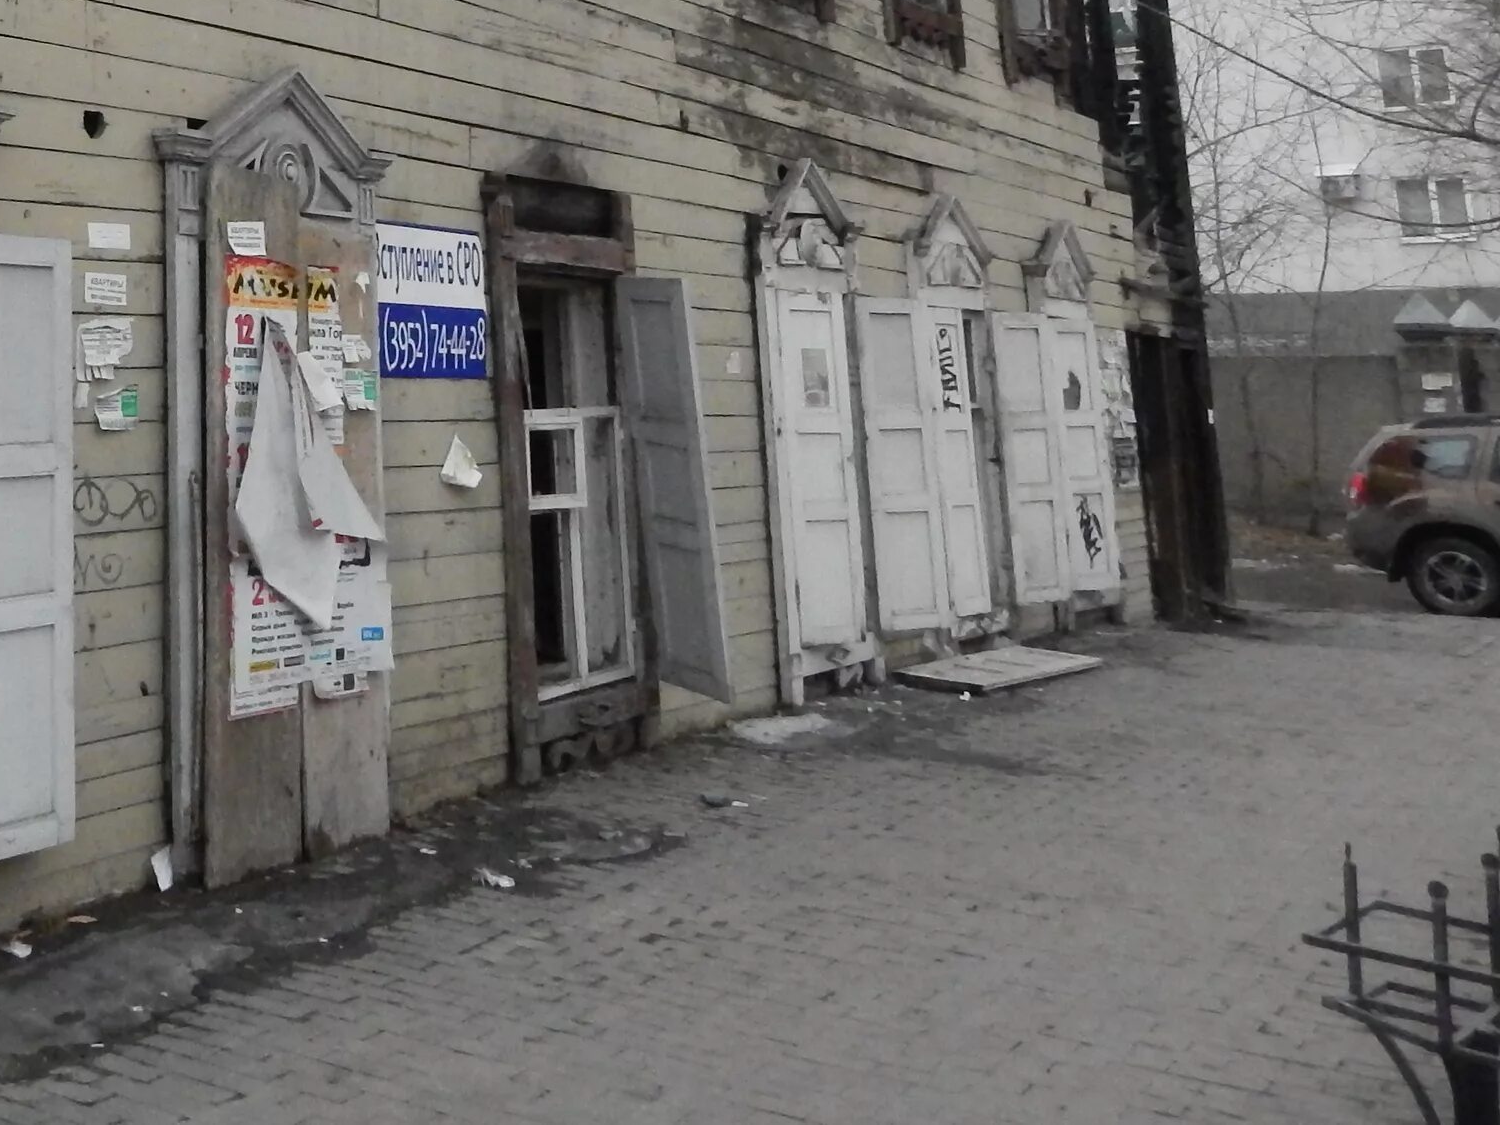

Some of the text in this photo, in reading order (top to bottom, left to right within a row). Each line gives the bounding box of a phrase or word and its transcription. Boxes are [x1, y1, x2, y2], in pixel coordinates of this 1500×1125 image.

[456, 240, 481, 288] СРО
[235, 314, 255, 345] 12
[430, 317, 485, 370] 74-44-28
